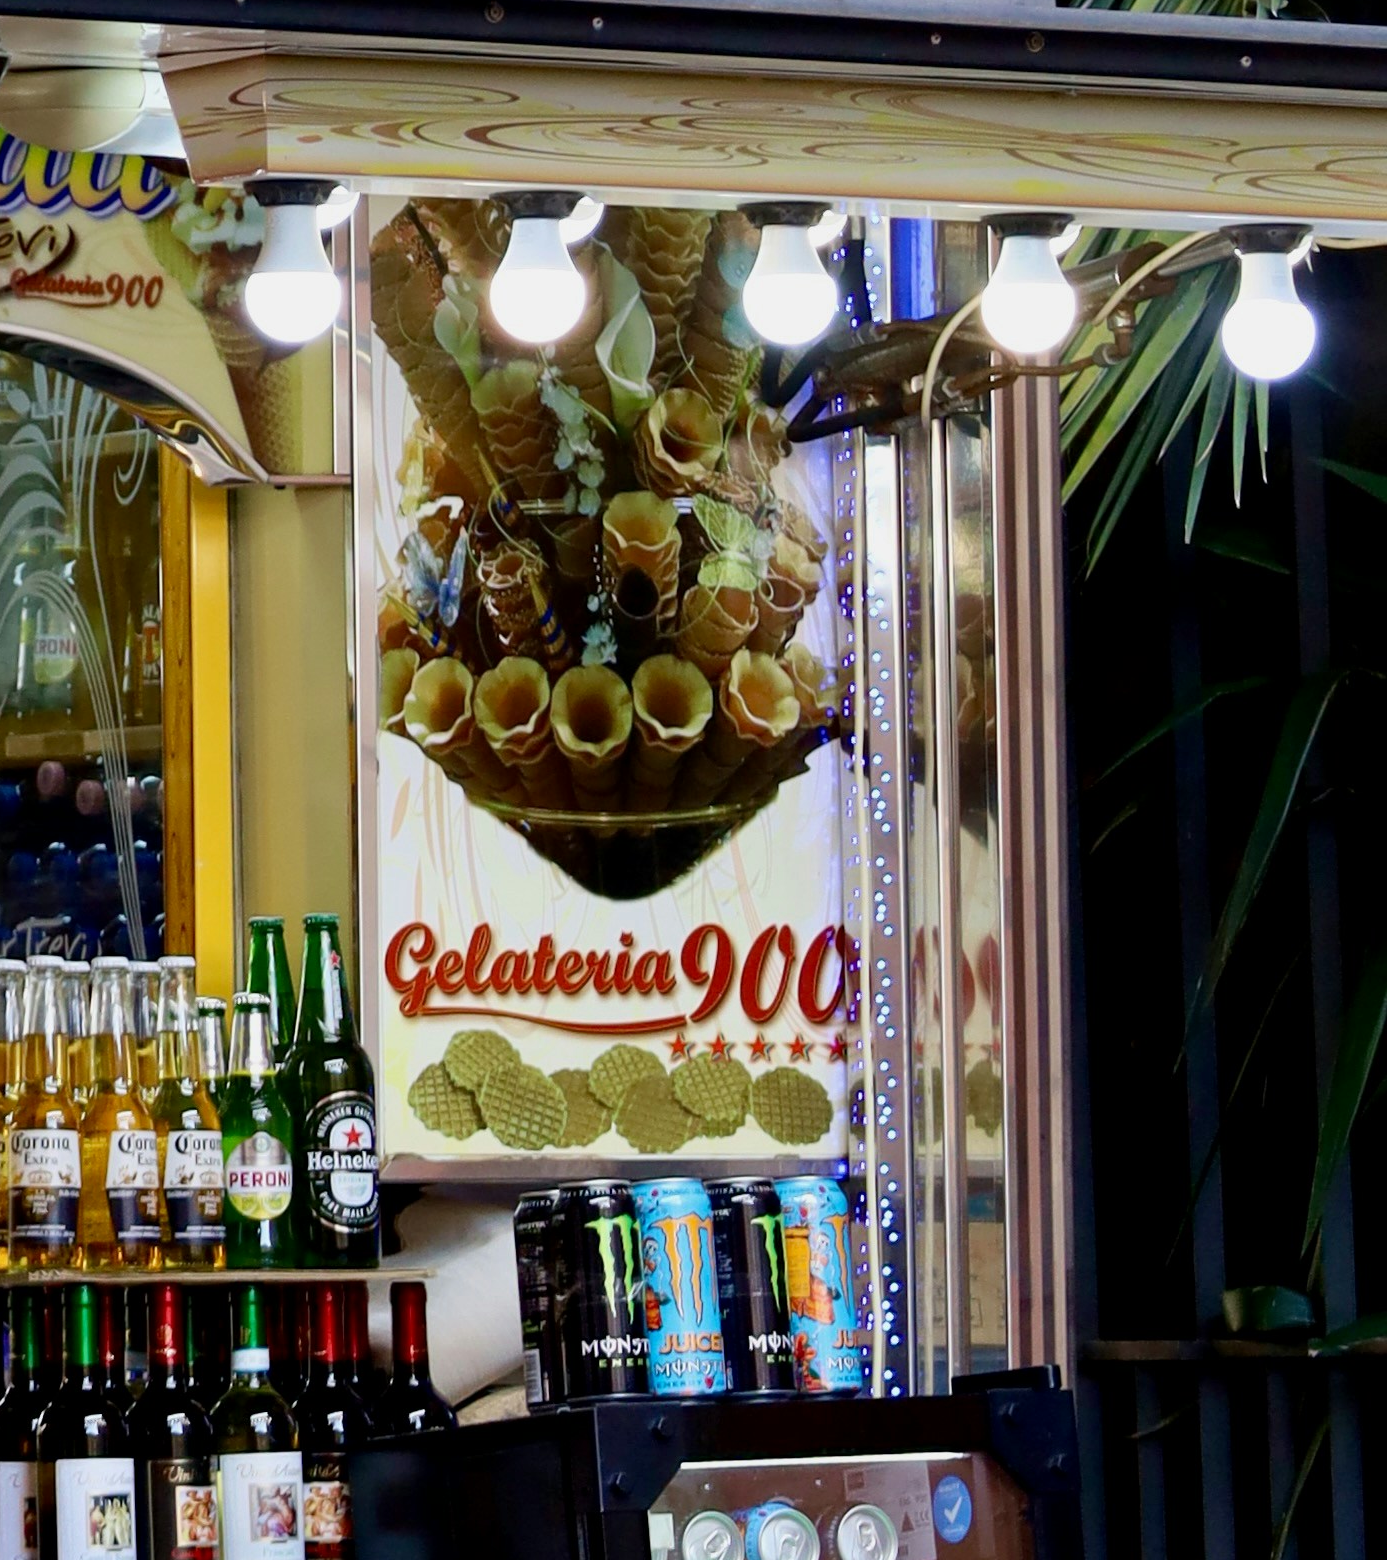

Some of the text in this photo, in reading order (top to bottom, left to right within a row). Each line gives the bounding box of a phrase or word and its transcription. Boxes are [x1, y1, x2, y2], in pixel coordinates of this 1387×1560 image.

[105, 274, 165, 308] 900
[383, 919, 855, 1027] Gelateria 900
[11, 1128, 71, 1153] Corona
[174, 1130, 223, 1155] Coron
[306, 1151, 378, 1170] Heineke
[229, 1170, 291, 1189] PERONI
[581, 1334, 649, 1358] MONST
[654, 1359, 724, 1377] MONST
